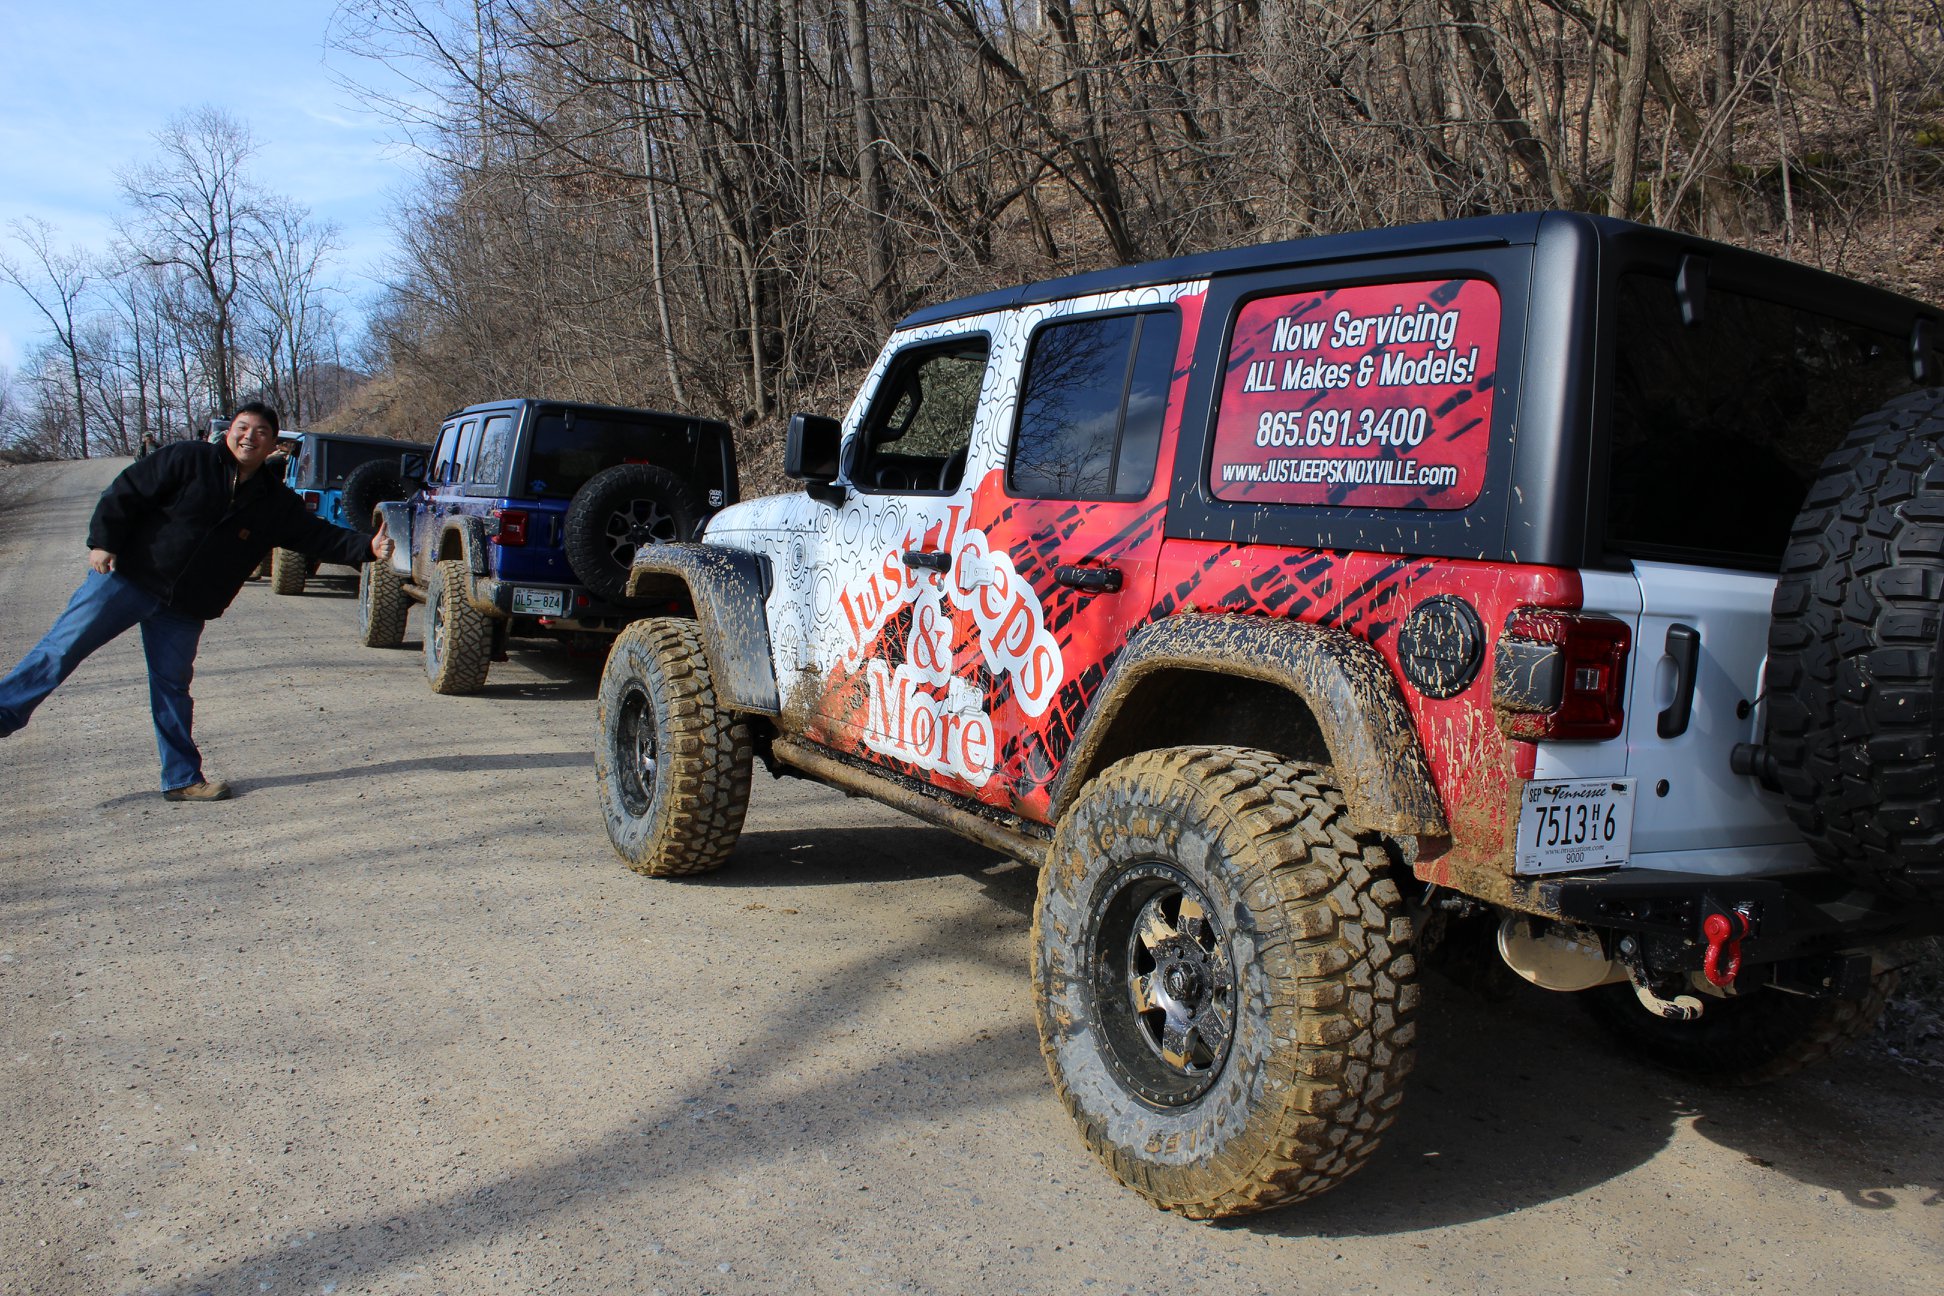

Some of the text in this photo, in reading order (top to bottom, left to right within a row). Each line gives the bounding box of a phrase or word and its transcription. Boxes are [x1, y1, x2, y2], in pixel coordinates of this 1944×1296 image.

[1271, 303, 1459, 352] Now Servicing
[1243, 347, 1479, 392] ALL Makes & Models!
[1256, 407, 1427, 447] 865.691.3400
[1222, 458, 1457, 486] www.JUSTJEEPSKNOXVILLE.com
[837, 527, 918, 660] Just
[912, 604, 946, 673] &
[869, 671, 988, 774] More
[1528, 788, 1542, 803] SEP
[1551, 784, 1608, 803] Tennessee
[1565, 852, 1585, 864] 9000
